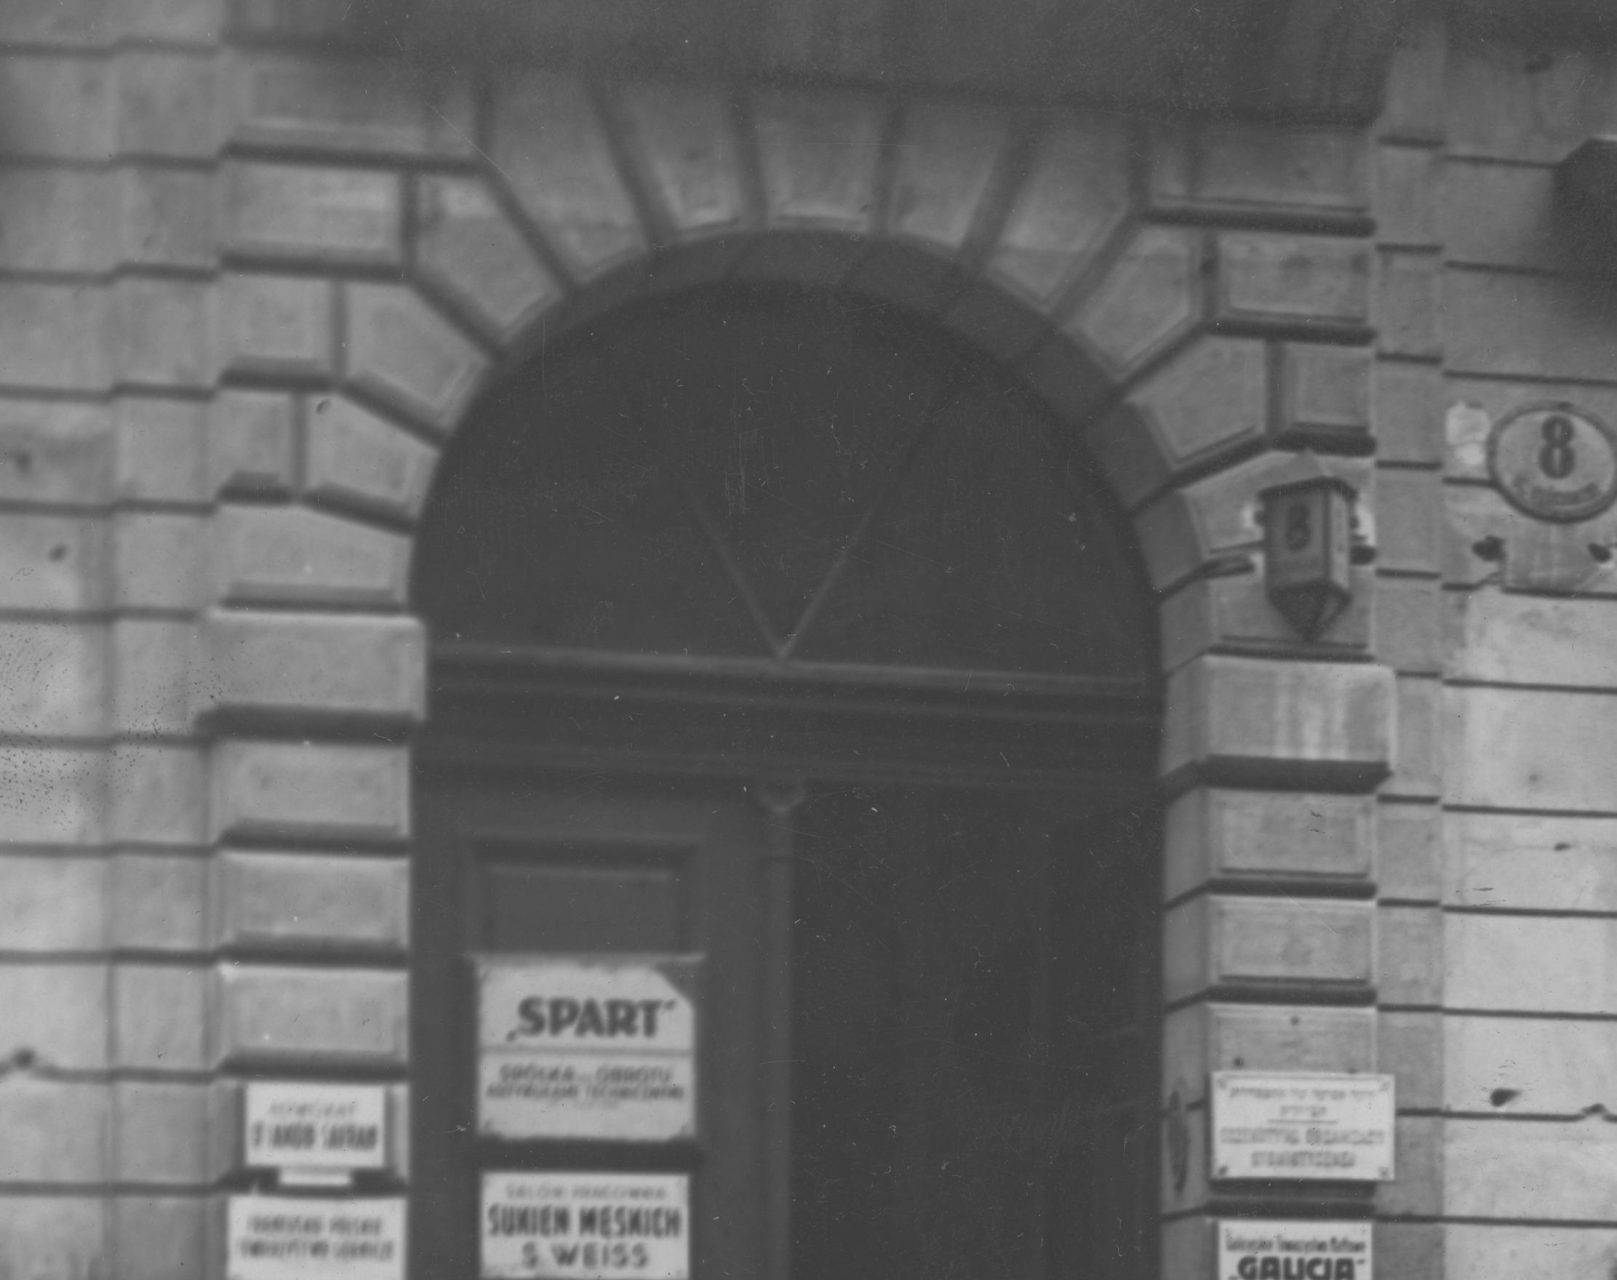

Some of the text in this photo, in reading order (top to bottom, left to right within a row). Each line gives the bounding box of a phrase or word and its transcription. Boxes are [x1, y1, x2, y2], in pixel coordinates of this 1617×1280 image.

[1539, 414, 1576, 479] 8
[1286, 503, 1311, 552] 8
[488, 1203, 570, 1237] SUKIEN
[550, 1243, 649, 1269] WEISS
